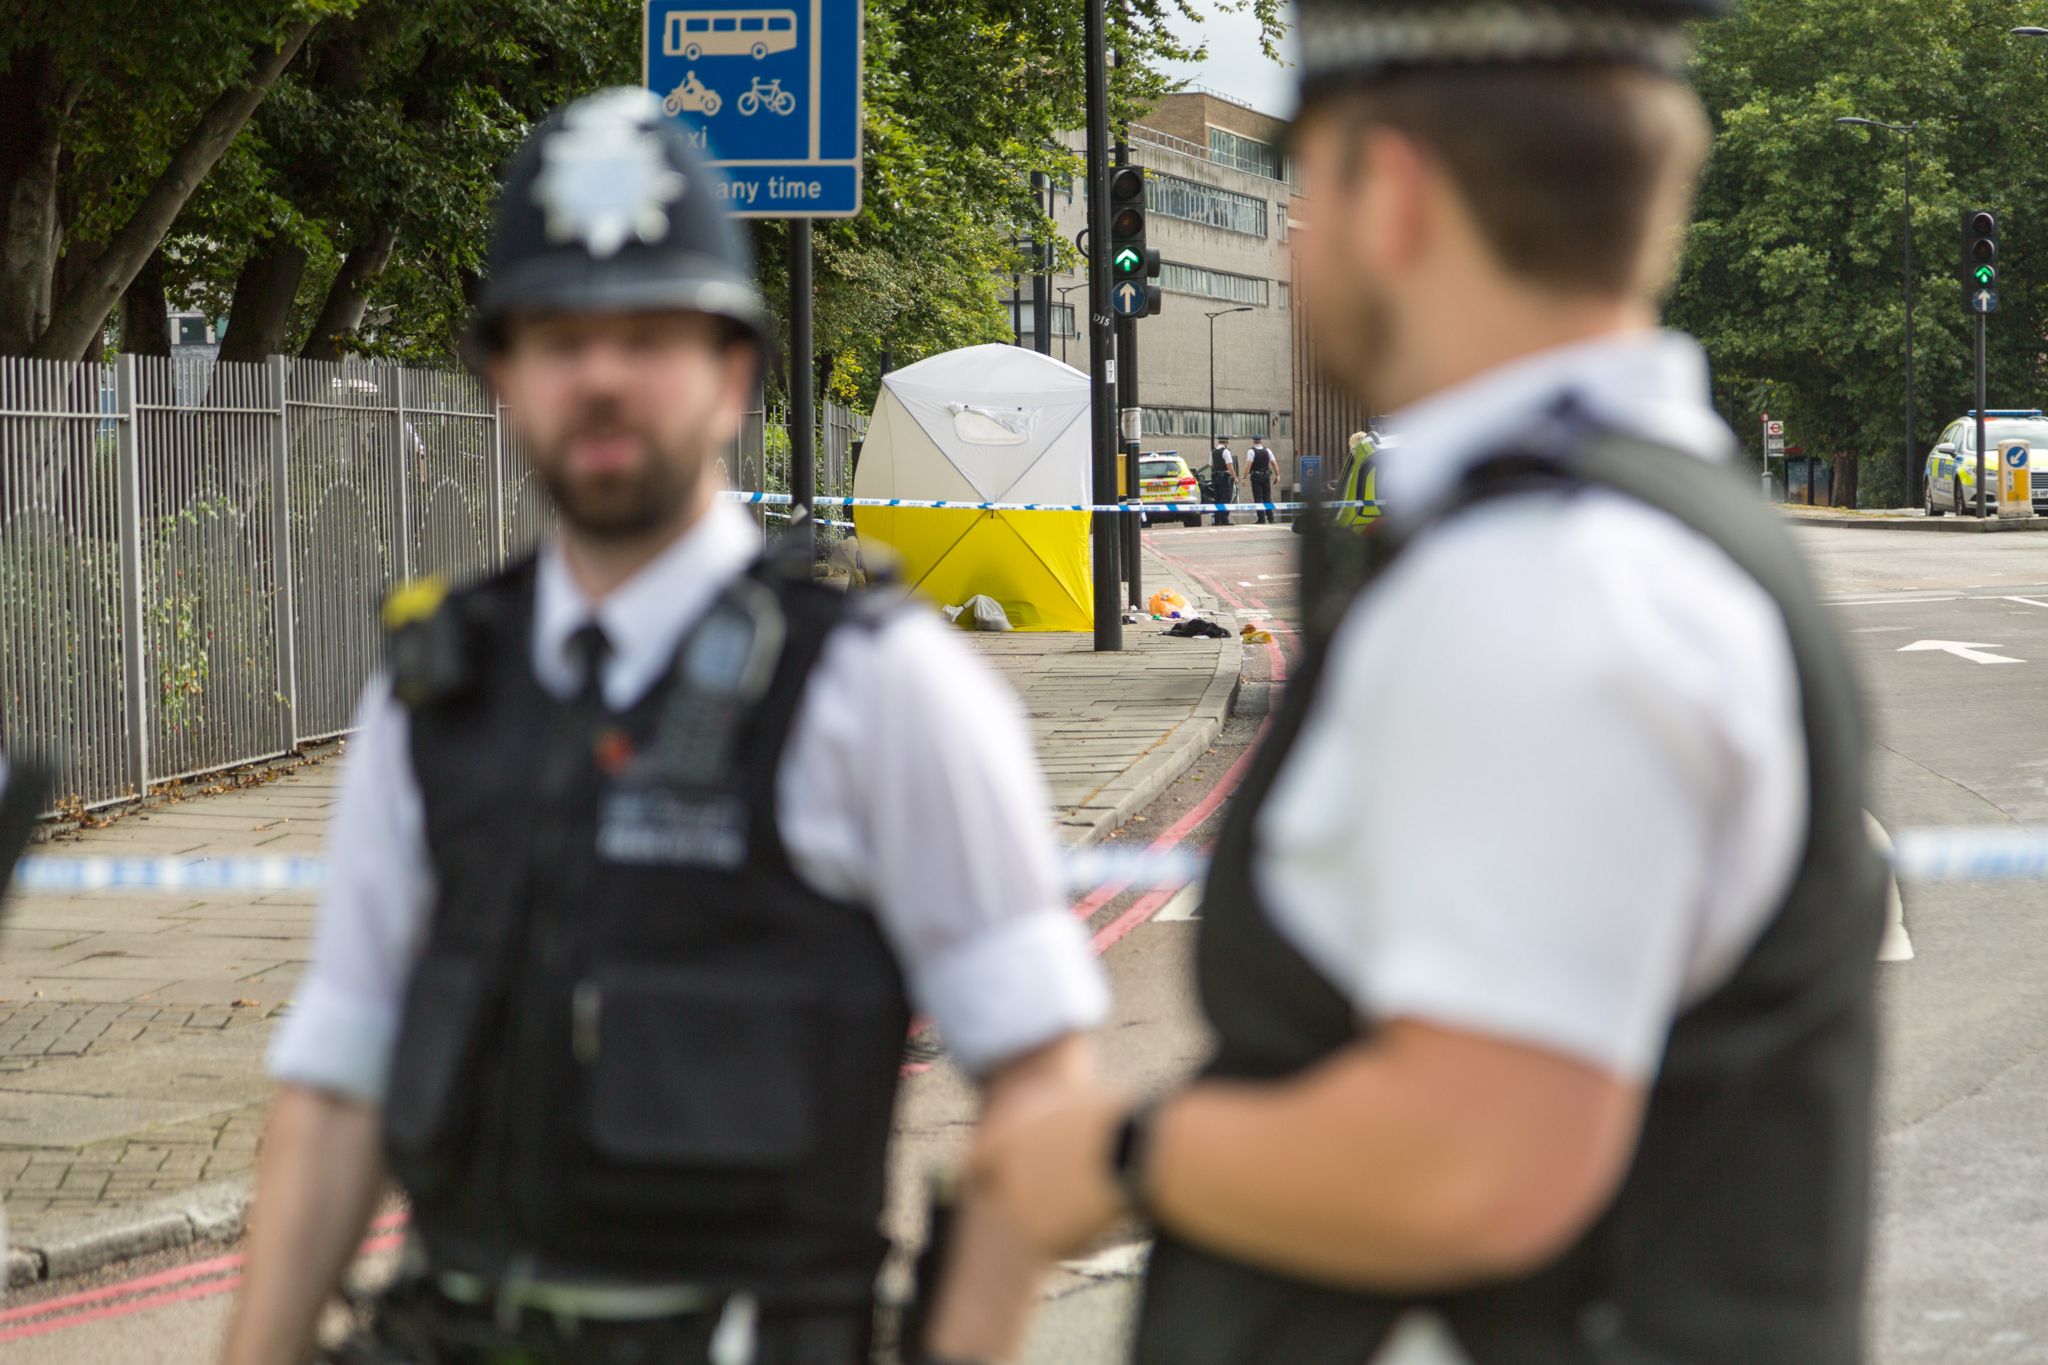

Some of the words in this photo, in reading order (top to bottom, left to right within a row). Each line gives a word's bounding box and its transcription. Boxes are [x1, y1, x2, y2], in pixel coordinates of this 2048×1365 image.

[687, 125, 708, 148] xi
[716, 181, 759, 203] any
[767, 175, 822, 199] time
